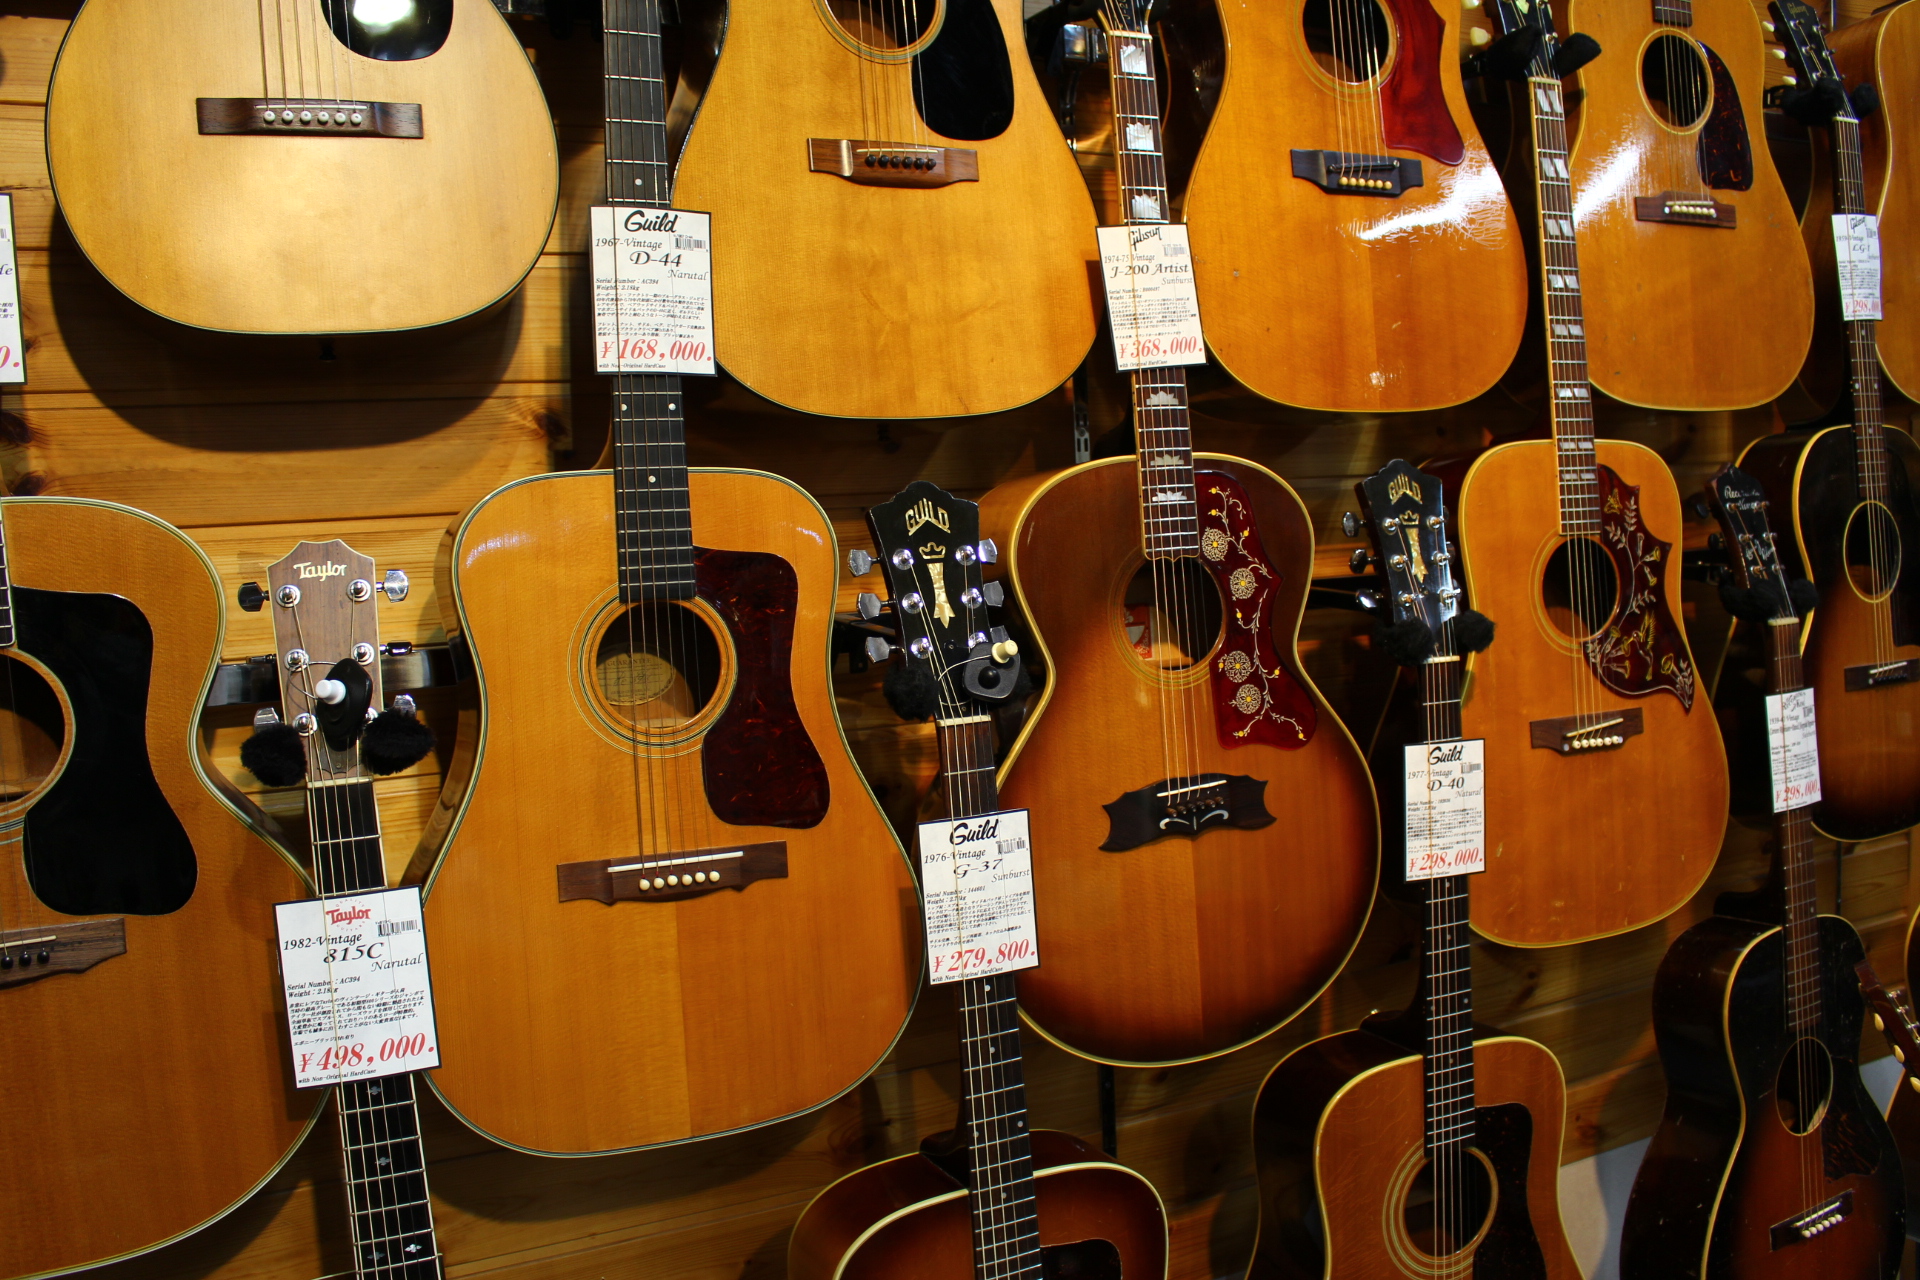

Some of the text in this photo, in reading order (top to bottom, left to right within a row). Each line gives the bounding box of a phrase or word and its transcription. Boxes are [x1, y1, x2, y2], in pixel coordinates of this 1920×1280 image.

[624, 210, 678, 233] Guild
[595, 238, 662, 251] 1967-Vintage
[1129, 227, 1162, 251] Gibson
[630, 251, 682, 267] D-44
[668, 270, 708, 280] Narutal
[1110, 263, 1189, 278] J-200 Artist
[1162, 277, 1193, 285] Sunburst
[600, 338, 712, 361] ¥168,000.
[1120, 336, 1203, 359] ¥368,000.
[1388, 473, 1423, 505] GUILD
[905, 498, 951, 536] GUILD
[293, 561, 347, 581] Taylor
[1428, 745, 1464, 765] Guild
[1427, 776, 1464, 791] D-40
[949, 818, 999, 846] Guild
[954, 859, 1003, 879] G-37
[1408, 847, 1483, 873] ¥298,000.
[991, 869, 1030, 883] Sunburst
[325, 906, 371, 926] Taylor
[284, 933, 362, 951] 1982-Vintage
[323, 942, 385, 964] 815C
[370, 953, 424, 972] Narutal
[933, 938, 1035, 974] ¥279,800.
[307, 980, 334, 988] Numbe
[339, 976, 361, 984] AC394
[288, 990, 311, 998] Weight
[299, 1032, 434, 1074] ¥498,000.
